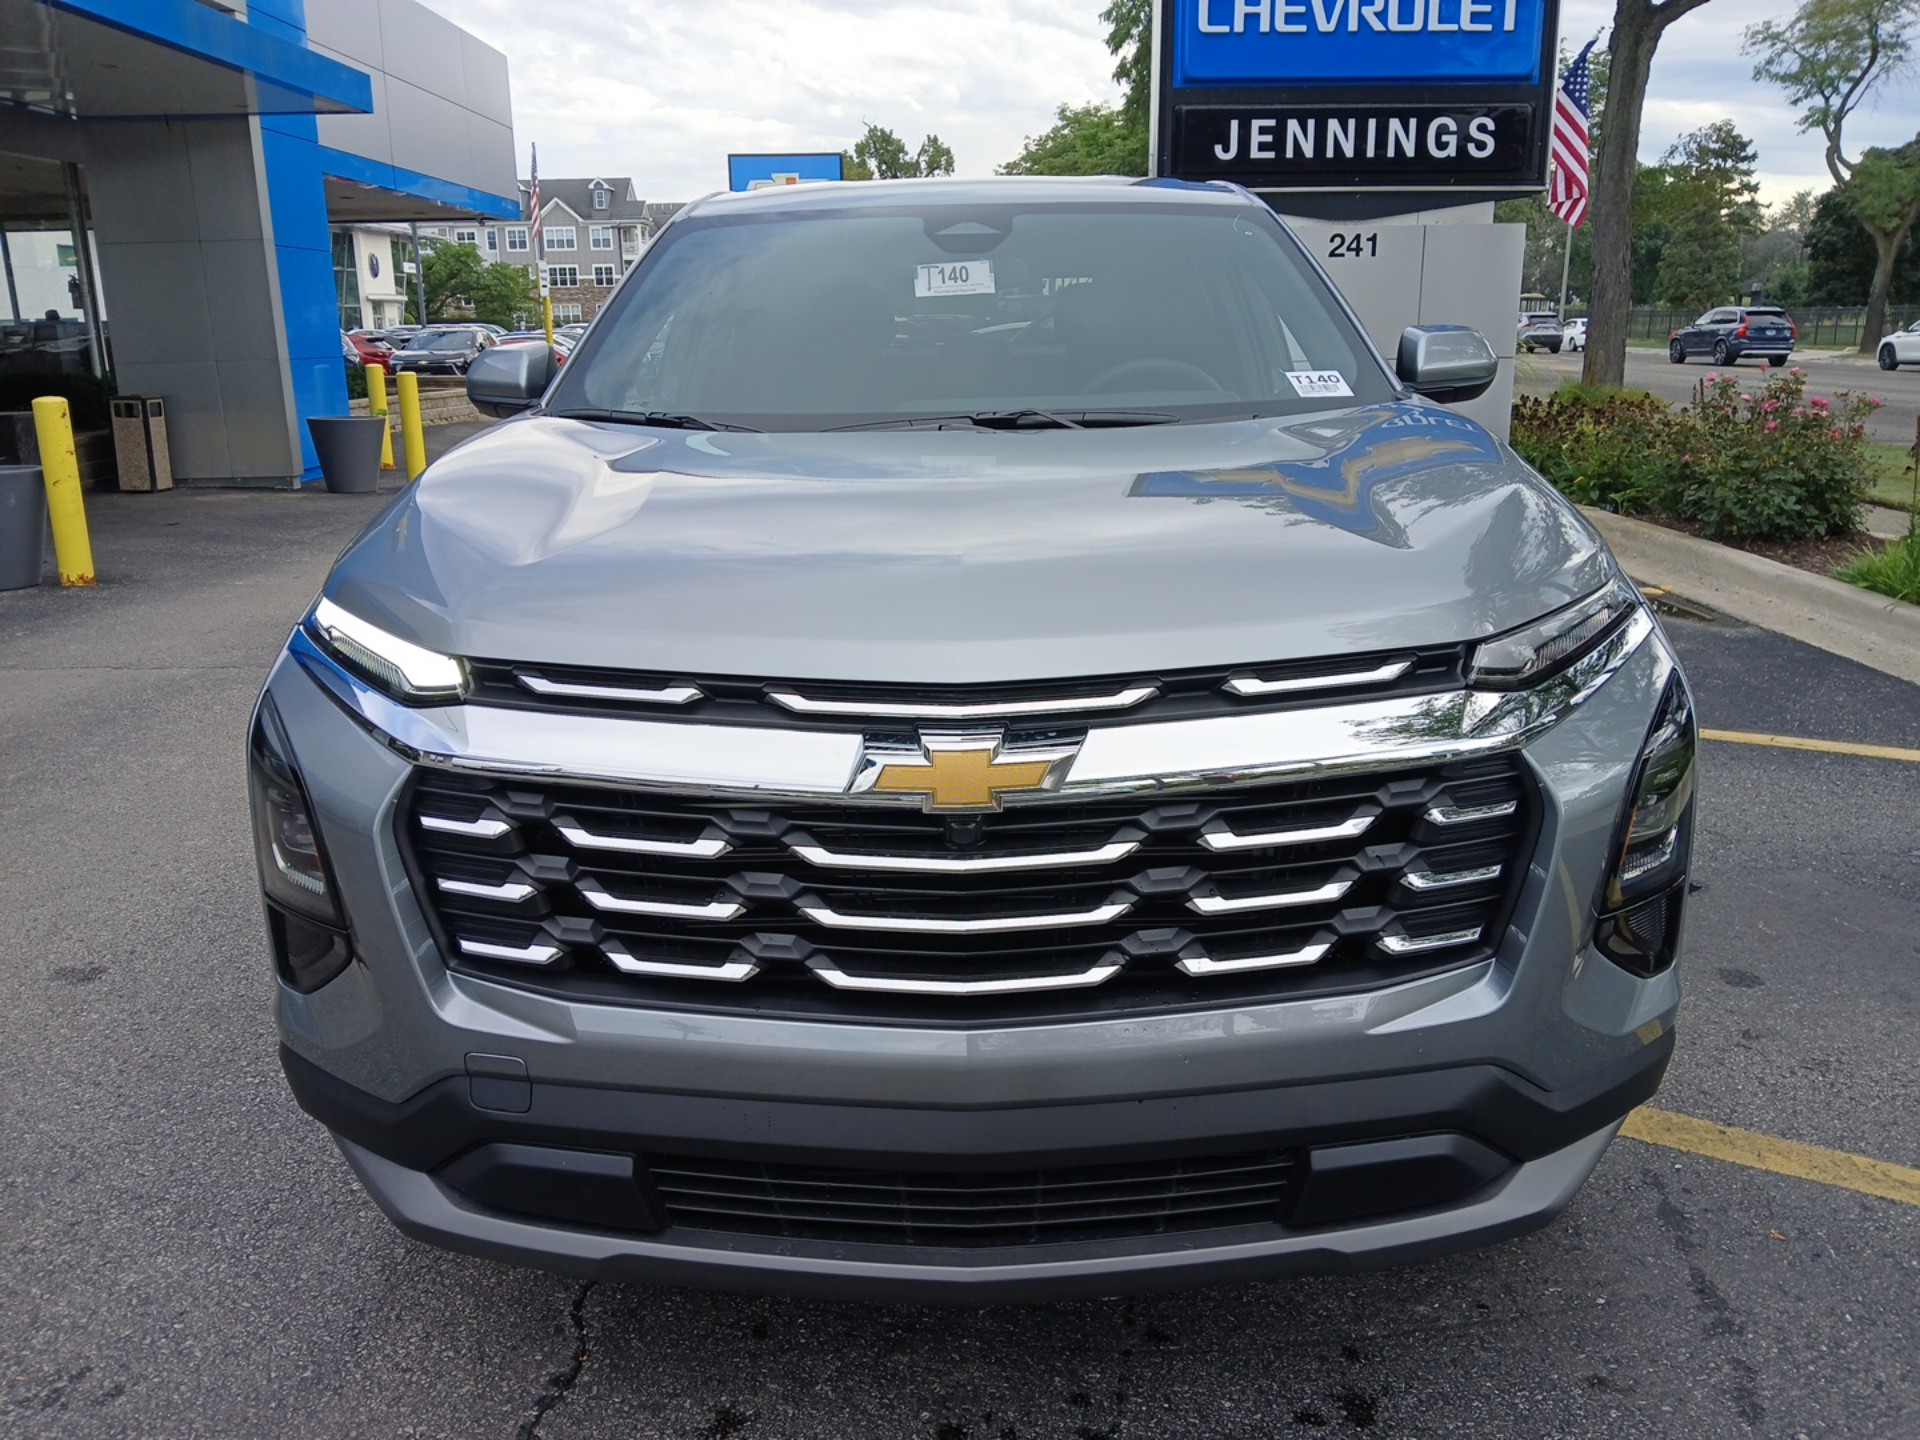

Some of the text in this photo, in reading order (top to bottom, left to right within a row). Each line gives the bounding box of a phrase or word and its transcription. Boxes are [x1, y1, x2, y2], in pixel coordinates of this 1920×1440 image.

[1214, 116, 1497, 161] JENNINGS
[1328, 233, 1378, 257] 241
[920, 265, 970, 292] T140
[1291, 375, 1341, 384] T140
